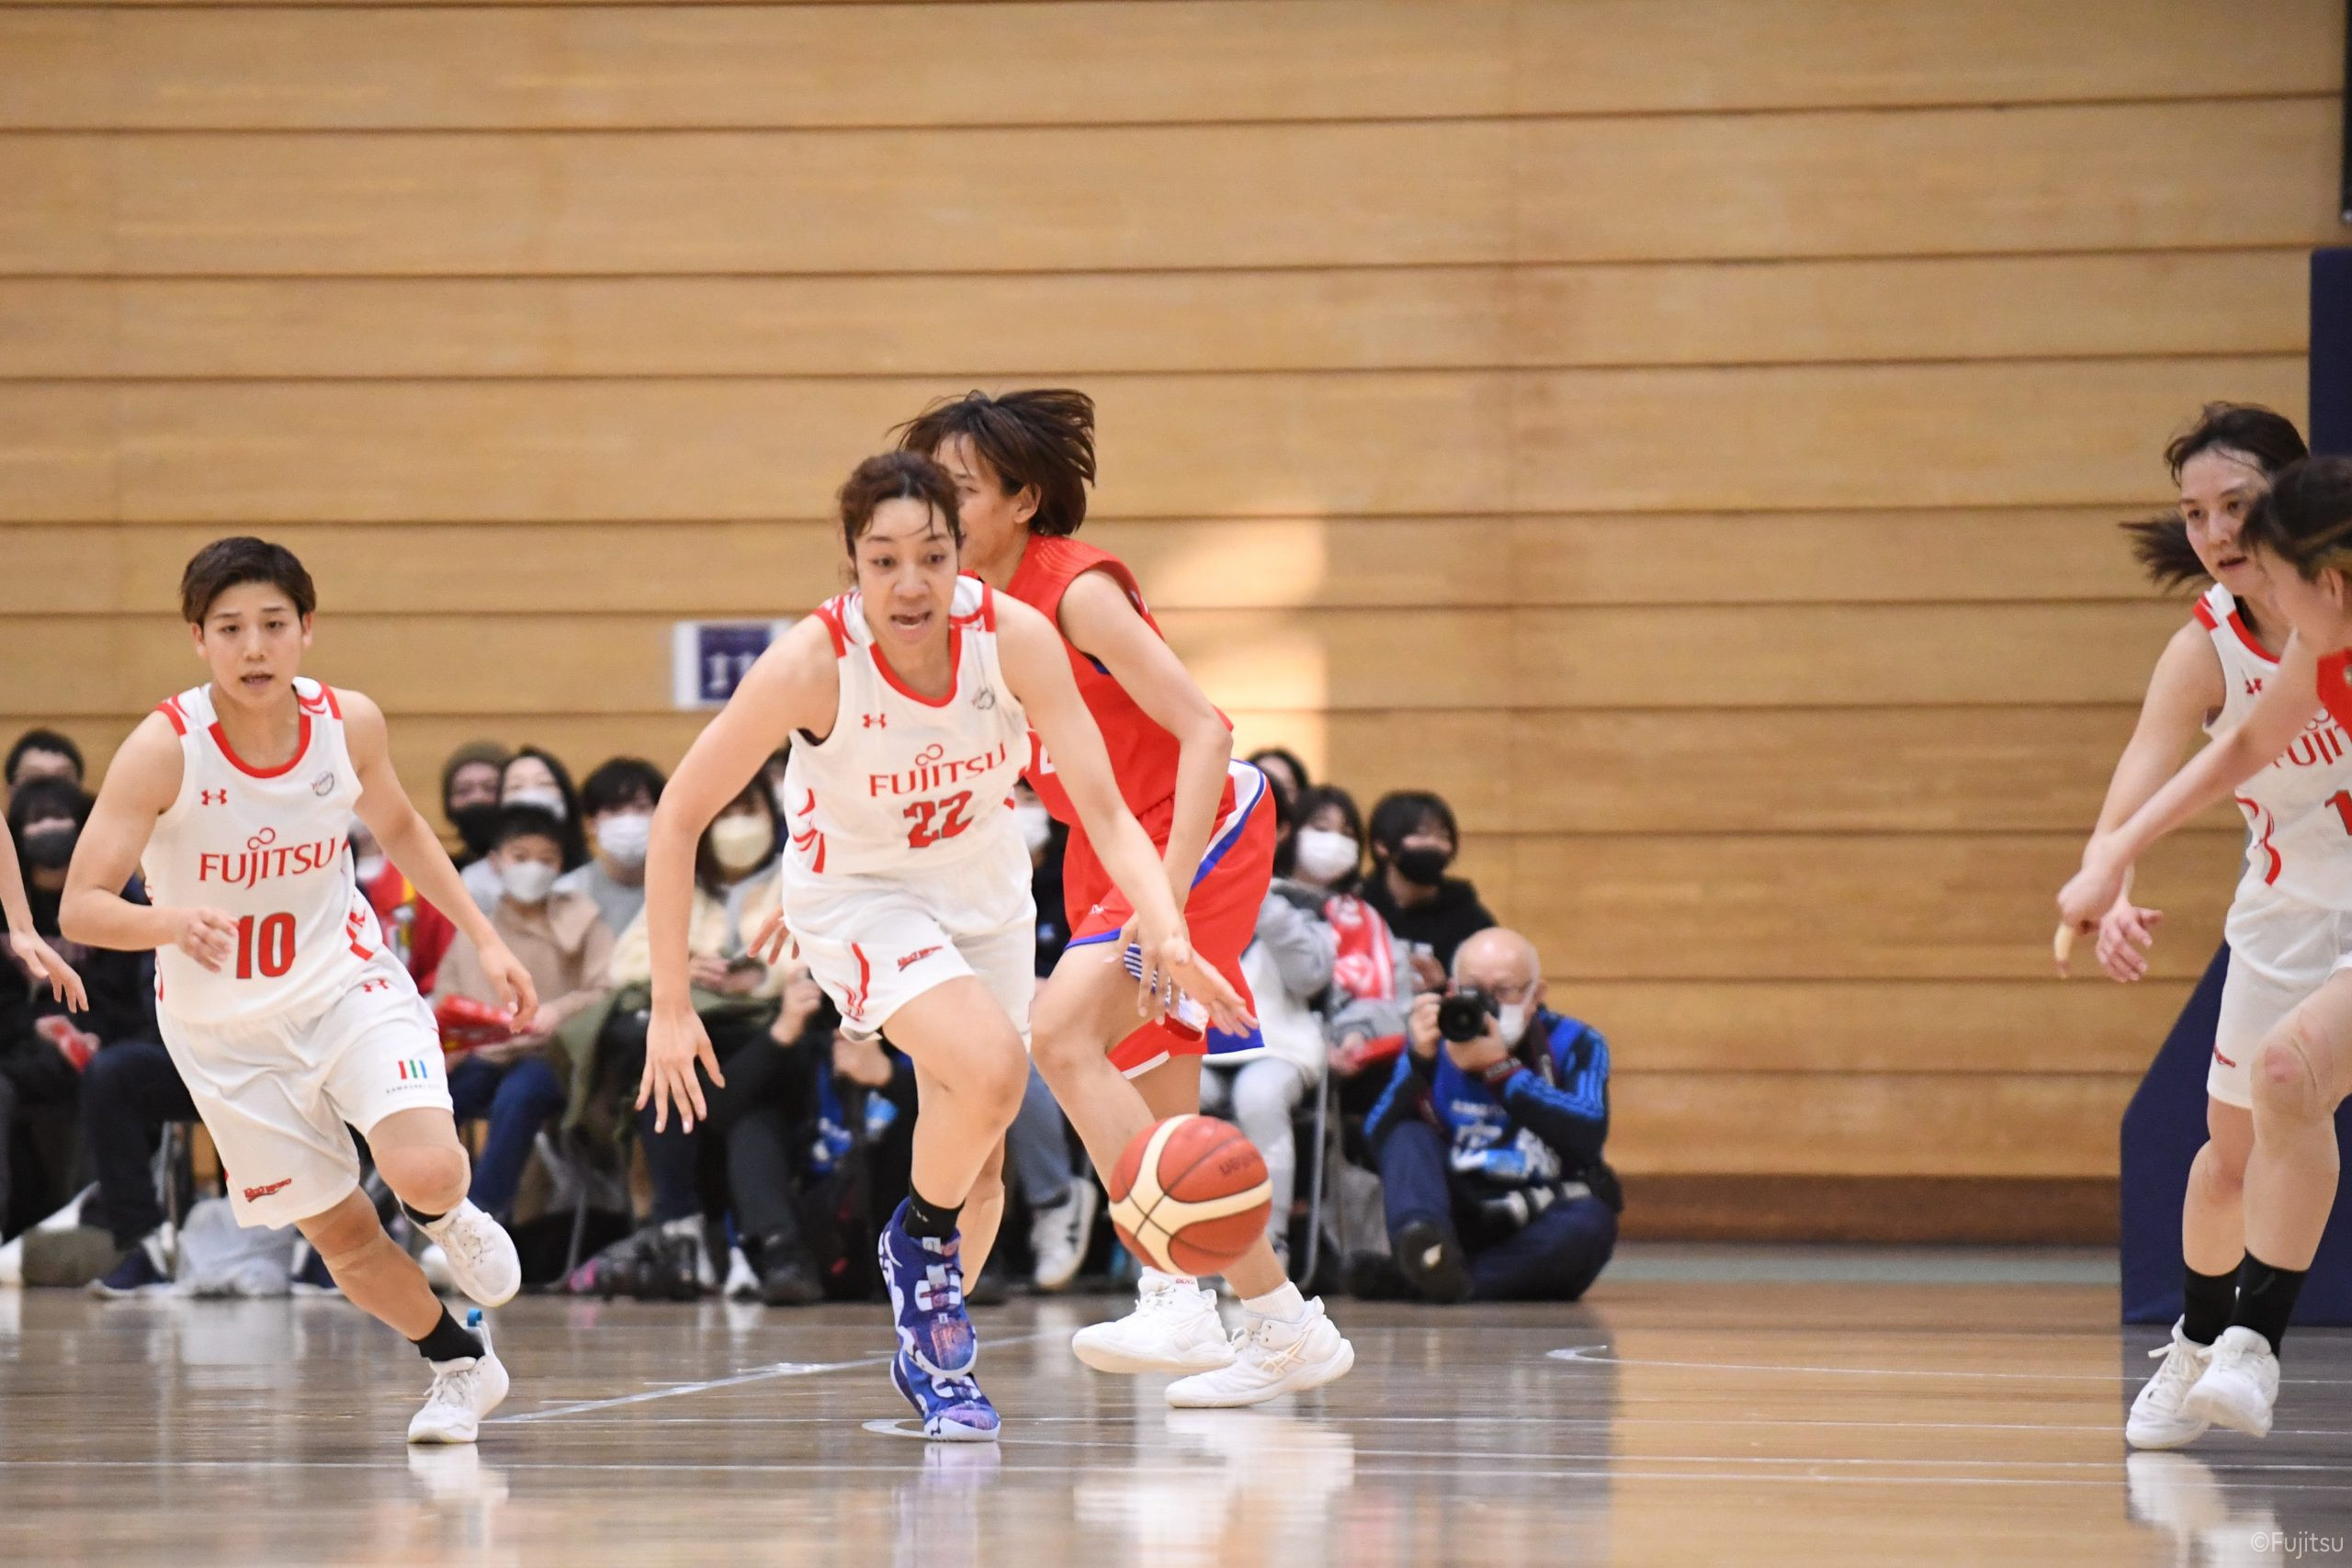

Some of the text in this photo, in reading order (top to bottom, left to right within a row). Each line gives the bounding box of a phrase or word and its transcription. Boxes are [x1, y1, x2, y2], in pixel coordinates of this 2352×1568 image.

[869, 743, 1006, 797] FUJITSU
[903, 790, 975, 849] 22
[199, 828, 335, 889] FUJITSU
[236, 912, 296, 979] 10
